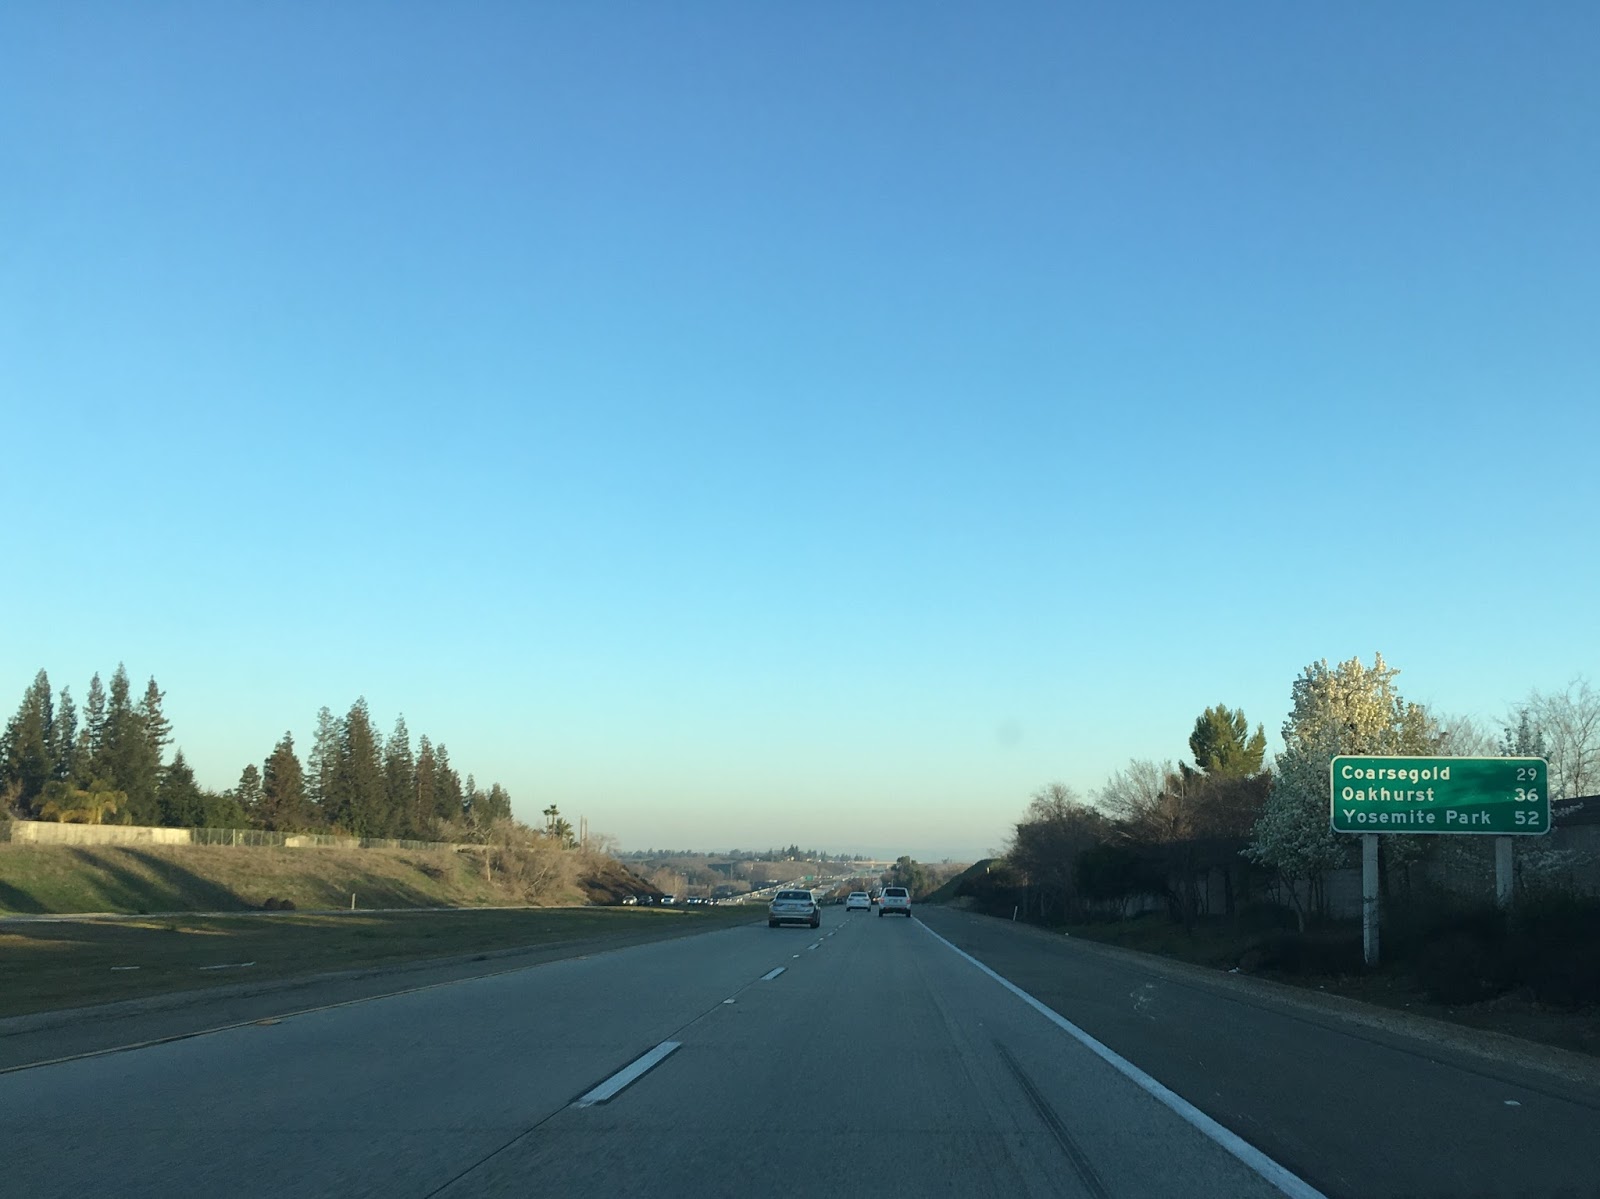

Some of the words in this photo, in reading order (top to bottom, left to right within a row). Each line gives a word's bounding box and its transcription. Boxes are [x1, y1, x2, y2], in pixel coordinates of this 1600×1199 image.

[1341, 765, 1451, 784] Coarsegold
[1516, 767, 1538, 782] 29
[1342, 787, 1435, 802] Oakhurst
[1515, 788, 1539, 802] 36
[1343, 809, 1436, 824] Yosemite
[1446, 810, 1491, 825] Park
[1515, 811, 1540, 825] 52
